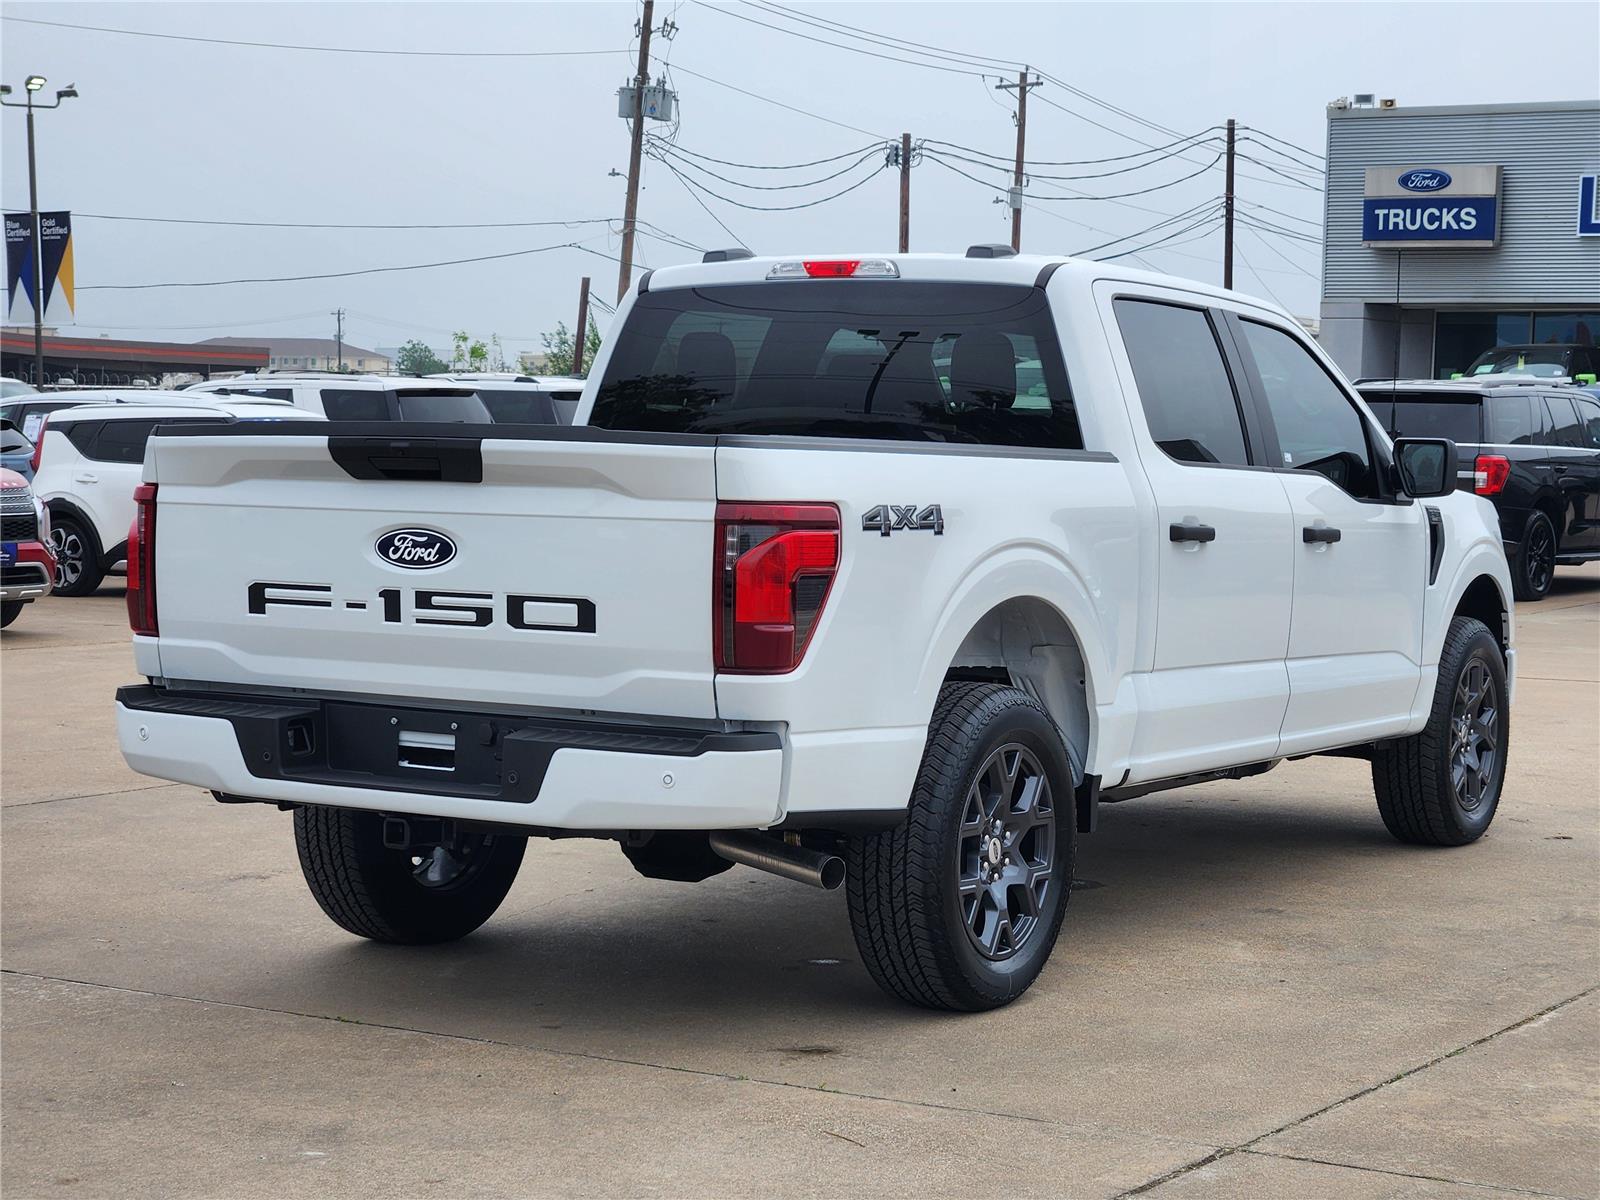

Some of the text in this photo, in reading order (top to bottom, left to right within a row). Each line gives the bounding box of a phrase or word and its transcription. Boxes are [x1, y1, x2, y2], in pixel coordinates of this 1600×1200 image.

[1407, 173, 1440, 187] Ford
[41, 218, 55, 226] Gold
[1374, 207, 1477, 231] TRUCKS
[6, 221, 20, 229] Blue
[42, 226, 67, 234] Certified
[6, 228, 30, 236] Certified
[389, 534, 440, 562] Ford
[247, 580, 597, 634] F-150
